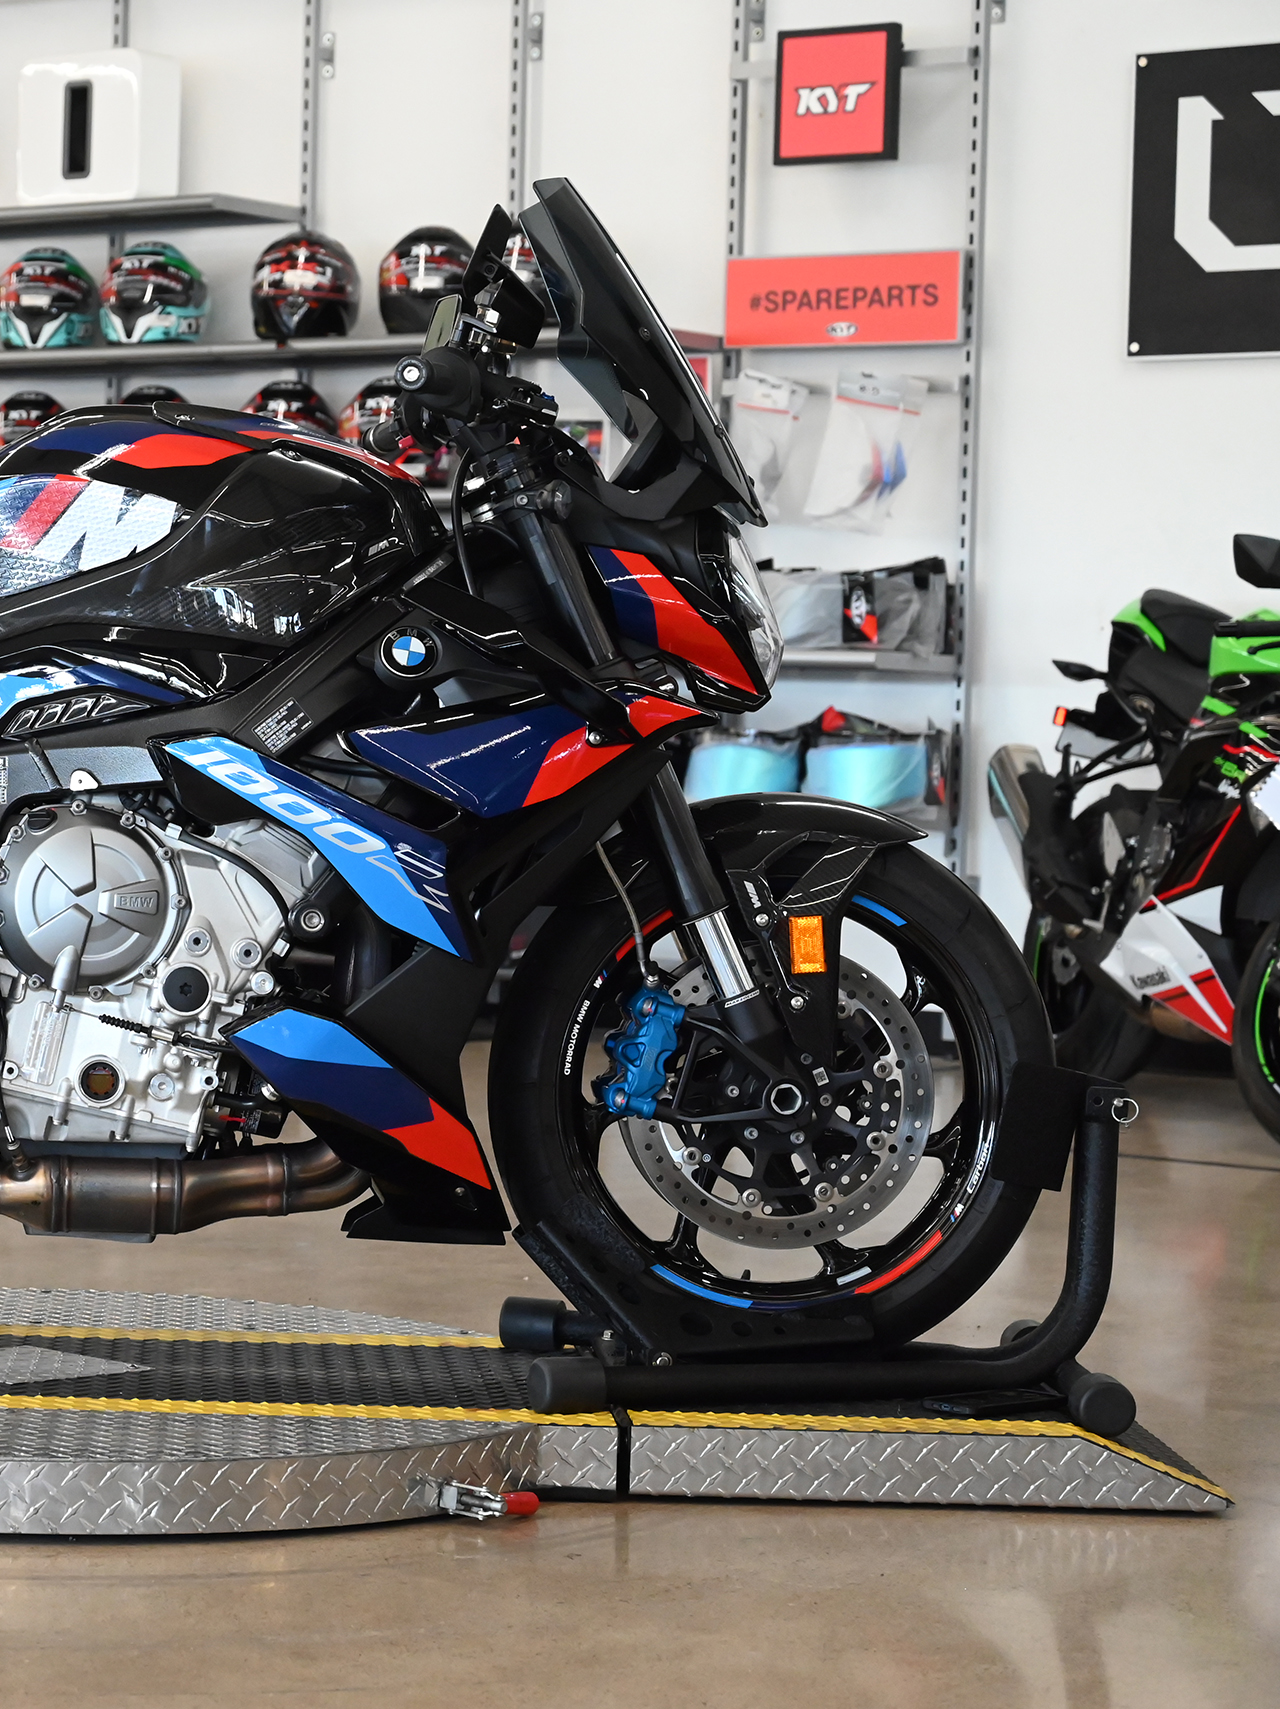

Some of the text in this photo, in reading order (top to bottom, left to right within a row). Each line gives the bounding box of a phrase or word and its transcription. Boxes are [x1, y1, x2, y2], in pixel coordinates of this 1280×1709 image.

[795, 81, 876, 116] KYT
[750, 284, 939, 313] #SPAREPARTS
[390, 628, 435, 647] BMW
[120, 895, 154, 908] BMW
[563, 999, 591, 1076] BMW MOTORRAD
